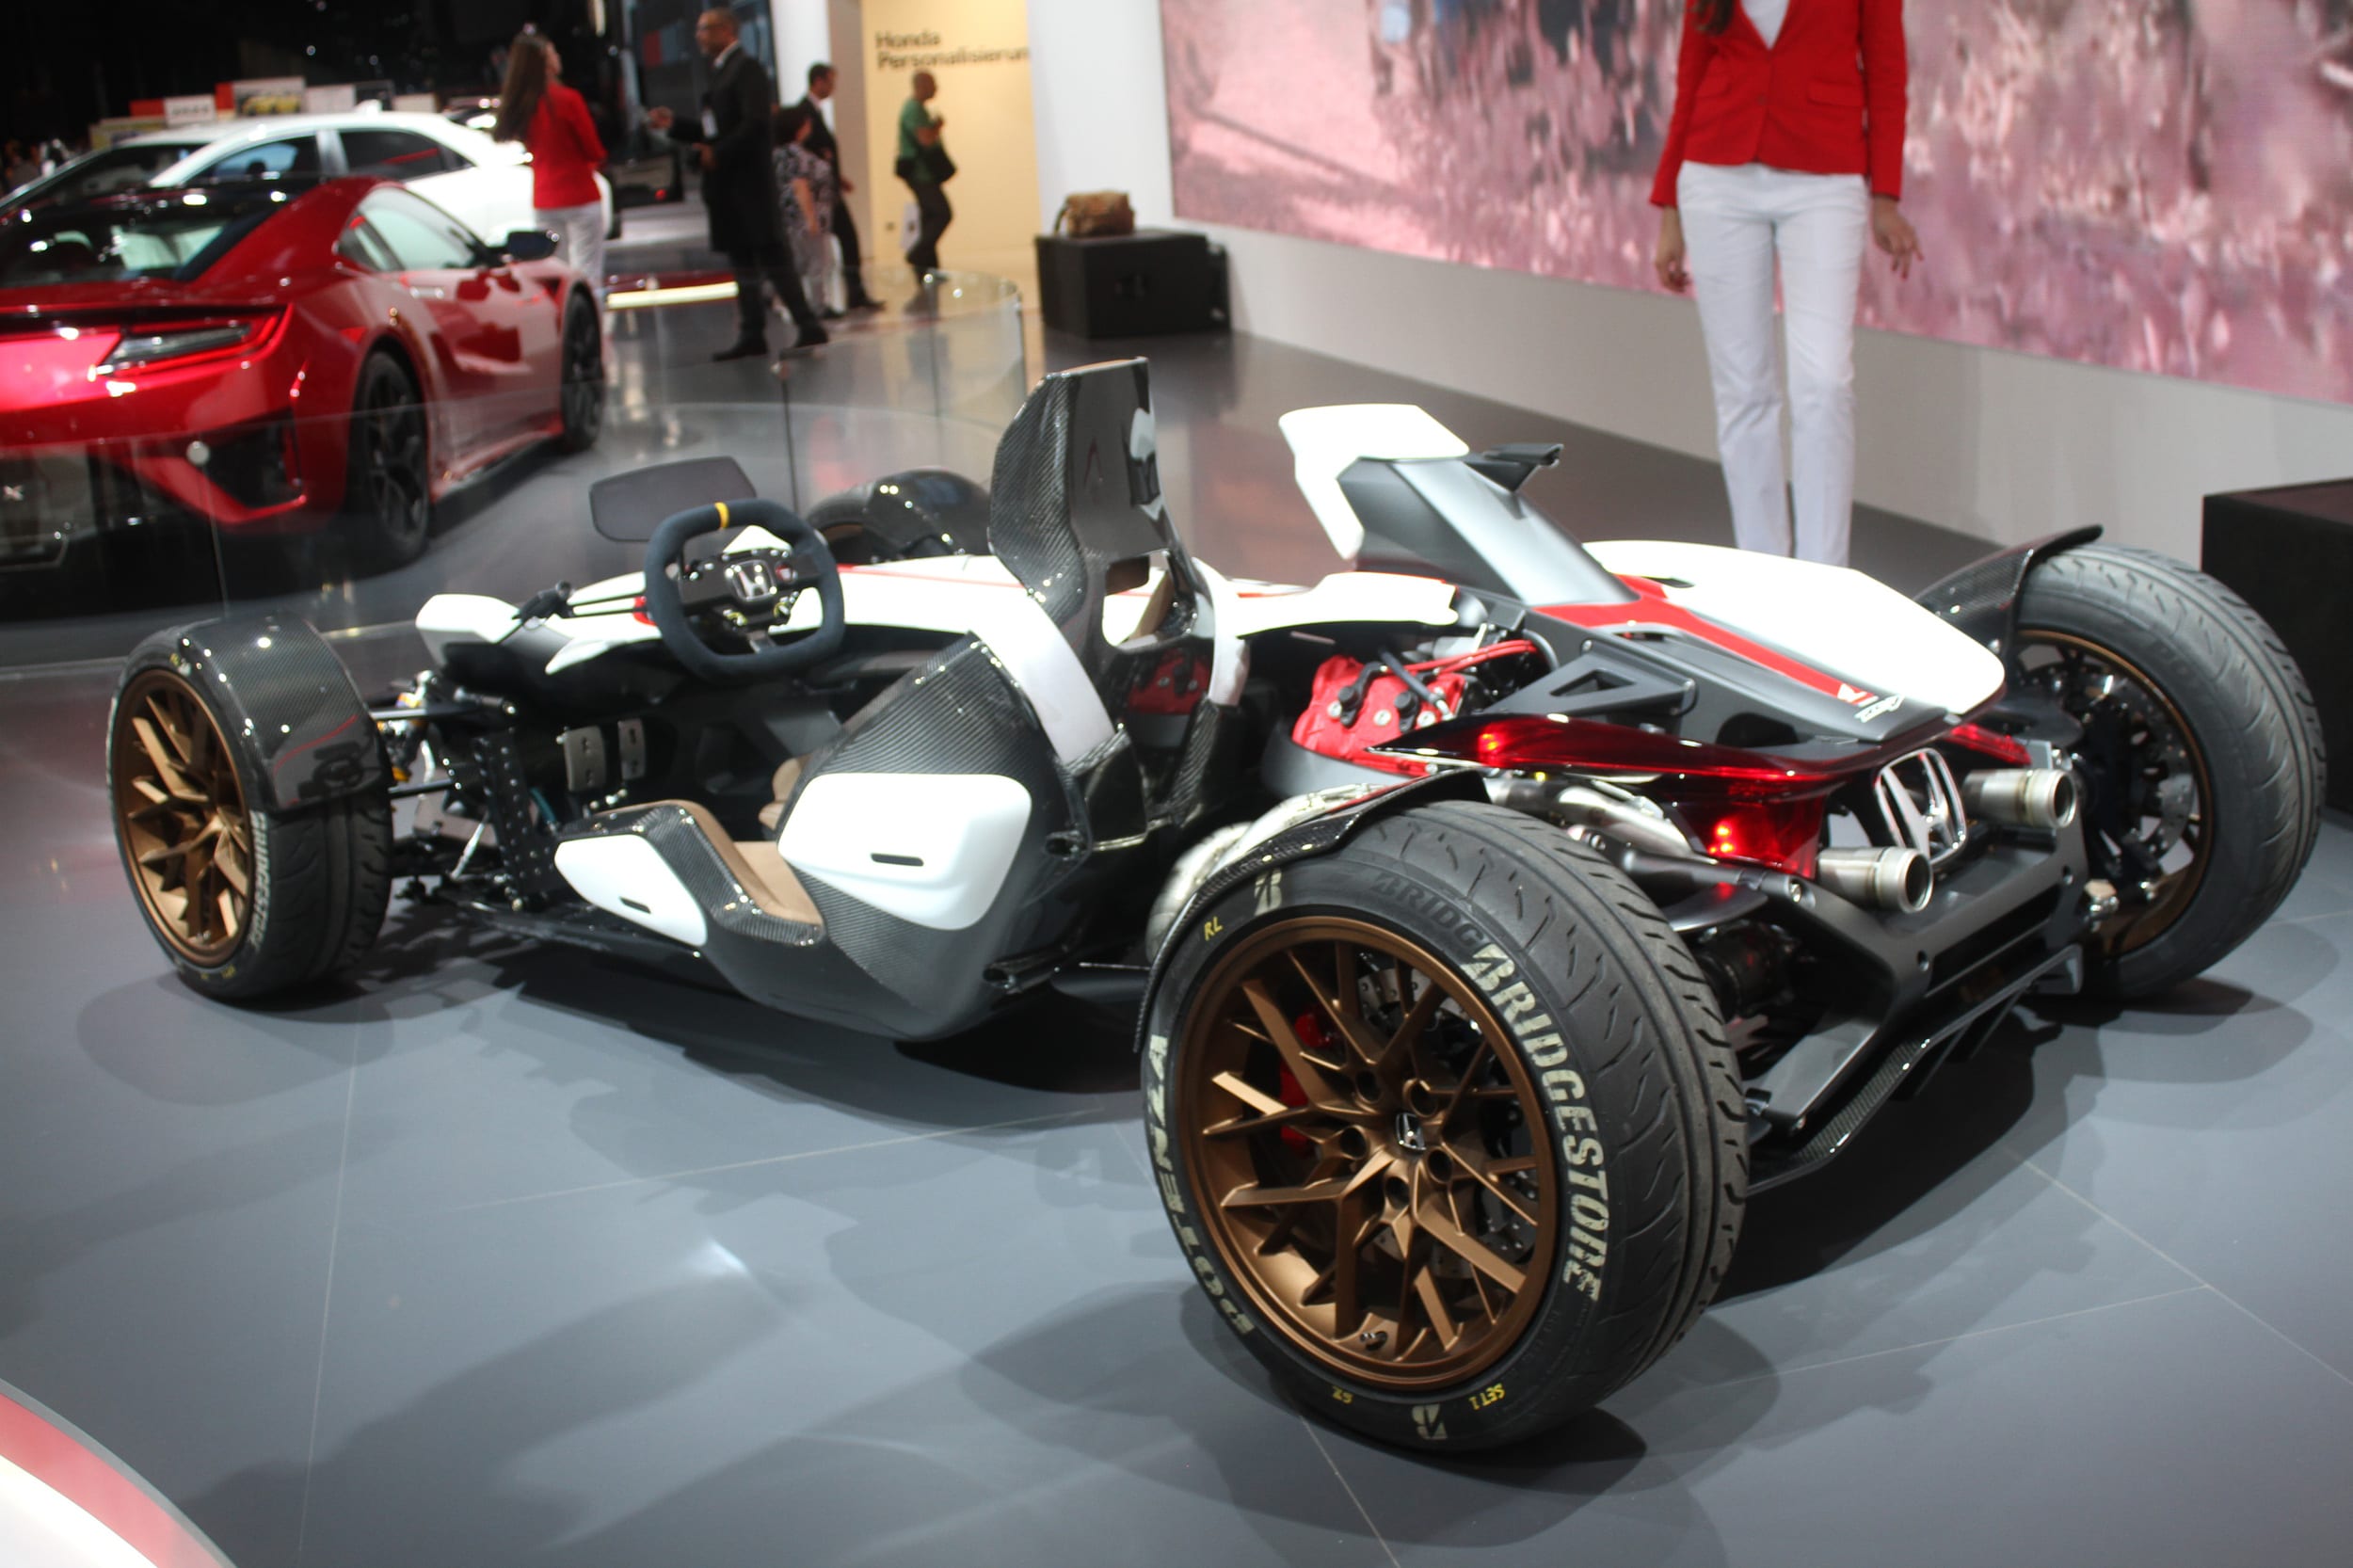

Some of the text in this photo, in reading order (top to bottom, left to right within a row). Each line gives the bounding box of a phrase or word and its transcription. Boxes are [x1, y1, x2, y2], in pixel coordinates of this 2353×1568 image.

[875, 29, 940, 49] Honda
[1204, 916, 1223, 941] RL
[1147, 1034, 1255, 1335] POTENZA
[1461, 943, 1609, 1302] BRIDGESTONE
